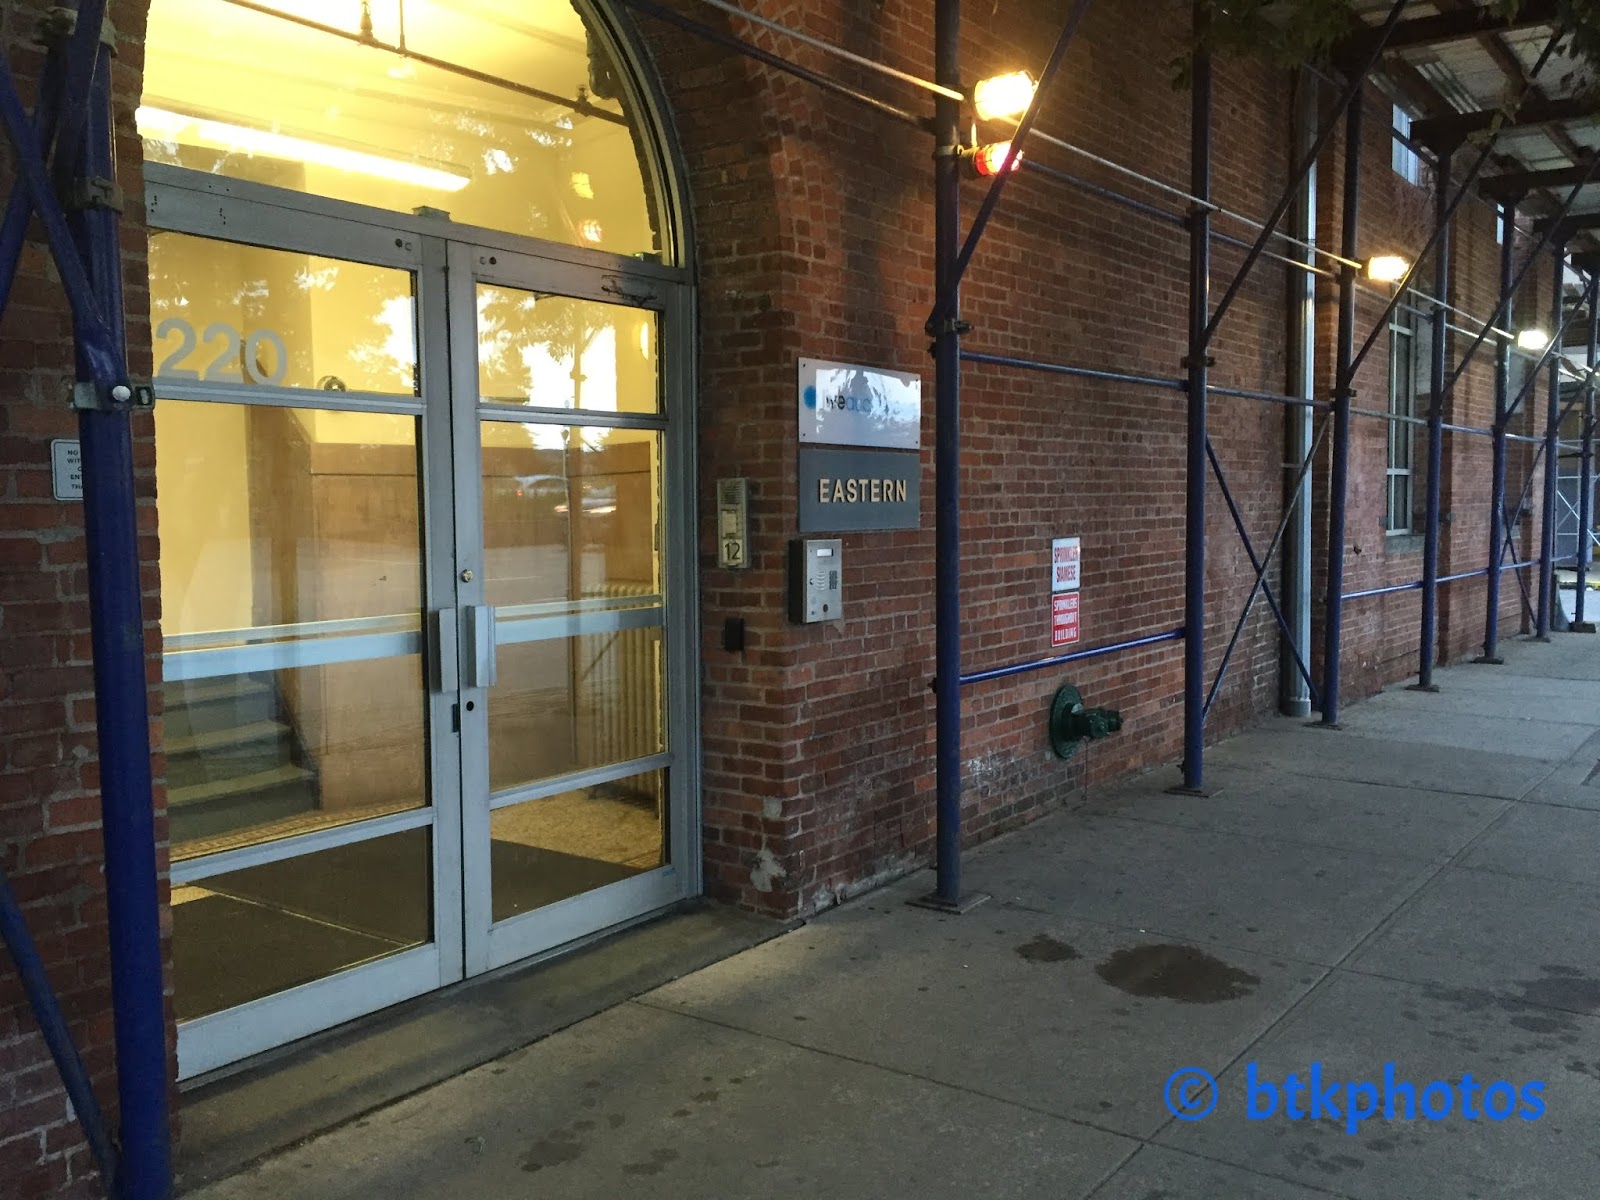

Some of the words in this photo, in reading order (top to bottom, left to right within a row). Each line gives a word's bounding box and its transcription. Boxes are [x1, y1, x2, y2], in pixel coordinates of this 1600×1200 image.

[156, 317, 288, 386] 220
[819, 478, 907, 502] EASTERN
[725, 542, 740, 560] 12
[1056, 565, 1076, 583] SIAMESE
[1054, 627, 1077, 641] BUILDING
